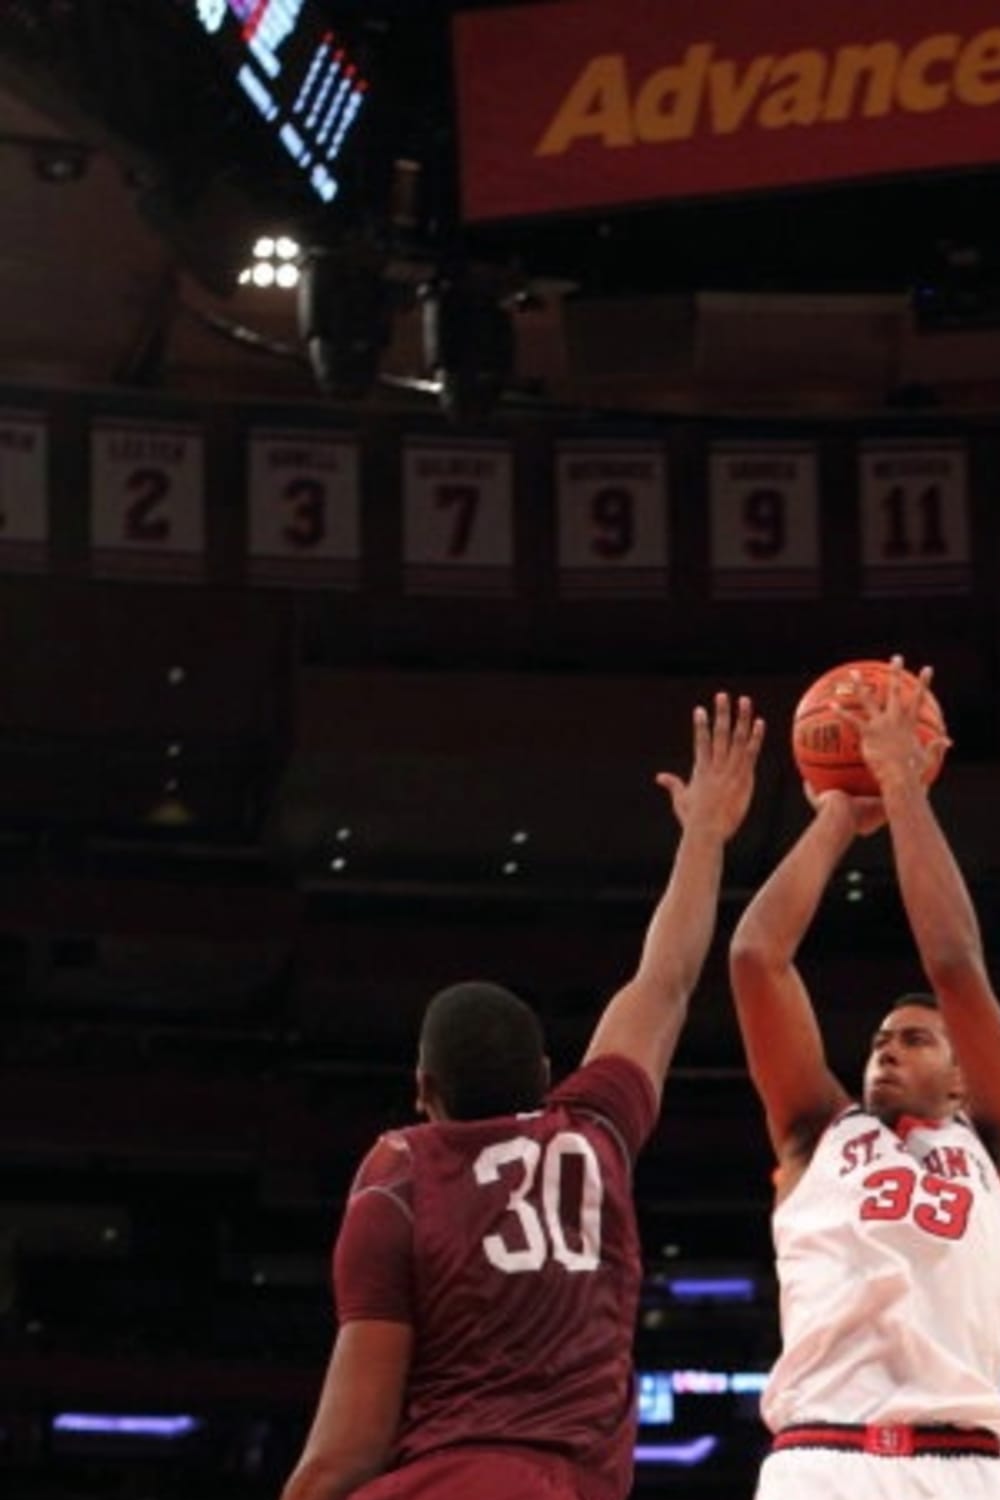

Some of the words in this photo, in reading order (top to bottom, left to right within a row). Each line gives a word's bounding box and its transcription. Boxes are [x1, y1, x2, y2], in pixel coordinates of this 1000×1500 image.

[125, 468, 170, 541] 2
[283, 480, 325, 547] 3
[434, 484, 479, 557] 7
[592, 487, 635, 559] 9
[743, 488, 786, 559] 9
[881, 484, 948, 558] 11
[473, 1131, 604, 1274] 30
[860, 1165, 974, 1241] 33
